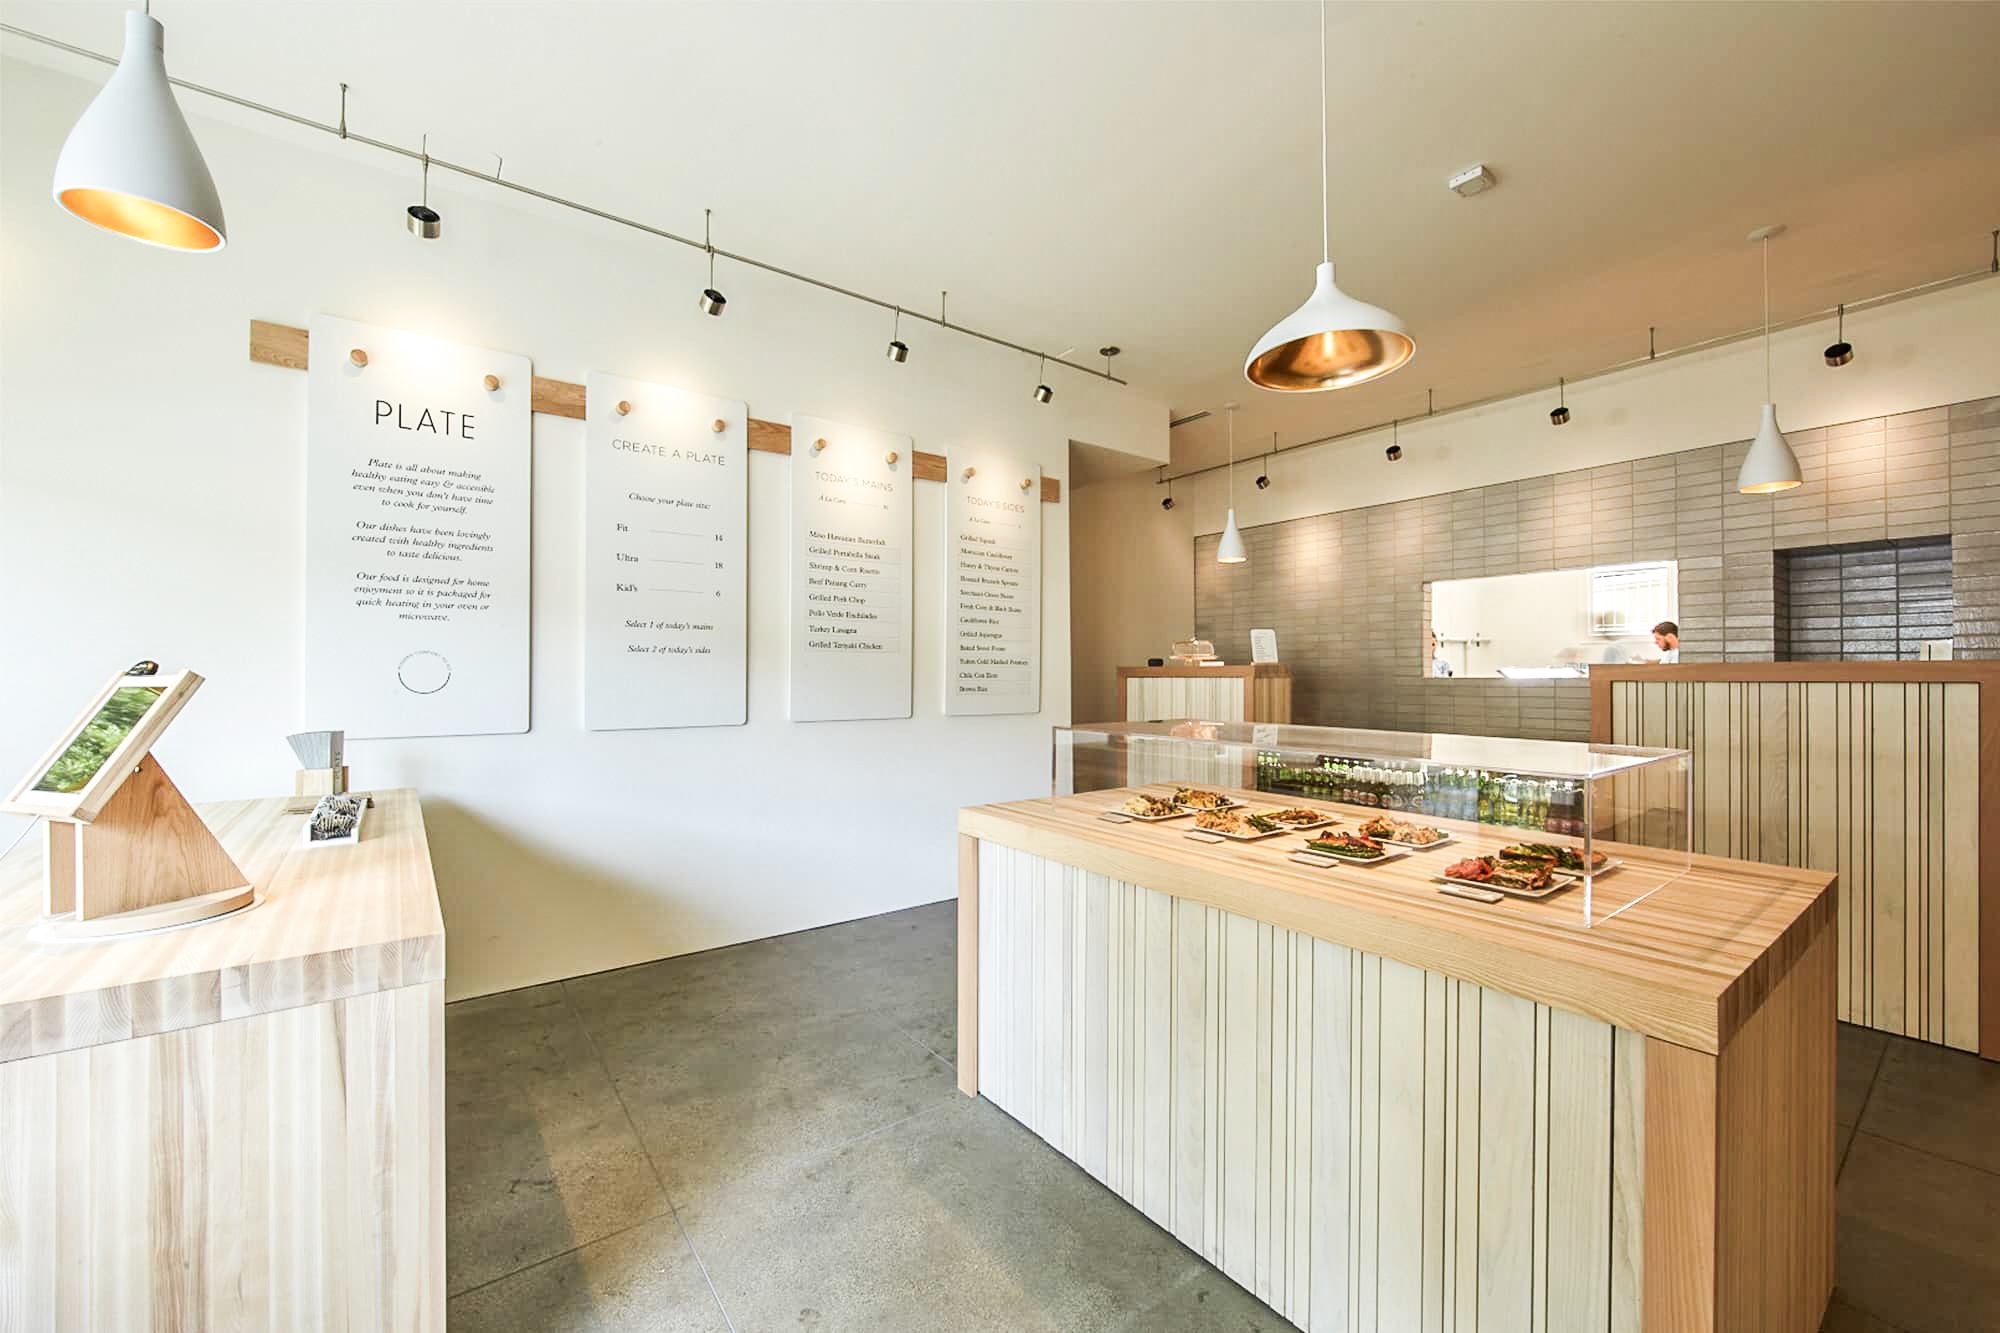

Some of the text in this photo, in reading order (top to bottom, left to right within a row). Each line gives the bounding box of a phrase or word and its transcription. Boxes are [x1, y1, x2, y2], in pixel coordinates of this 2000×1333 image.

[376, 400, 475, 440] PLATE
[612, 439, 725, 466] CREATE A PLATE
[368, 458, 481, 481] Plate is all about making
[352, 469, 495, 494] healthy eating easy & accessible
[353, 484, 375, 492] even
[379, 486, 403, 494] when
[426, 491, 448, 499] don't
[452, 494, 472, 502] have
[475, 496, 493, 504] time
[629, 492, 656, 502] Choose
[657, 497, 673, 505] your
[676, 498, 694, 507] plate
[416, 502, 430, 511] for
[431, 505, 468, 515] yourself.
[968, 496, 1024, 512] TODAY'S SIDES
[356, 521, 491, 541] Our dishes have been lovingly
[617, 523, 628, 532] Fit
[352, 535, 386, 543] created
[413, 539, 445, 549] healthy
[448, 542, 493, 552] ingredients
[423, 551, 462, 562] delicious.
[809, 546, 831, 555] Grilled
[616, 553, 638, 562] Ultra
[809, 562, 832, 571] Shrimp
[356, 571, 489, 587] Our food is designed for home
[849, 581, 867, 589] Curry
[354, 584, 402, 595] enjoyment
[427, 588, 433, 596] is
[436, 589, 477, 599] packaged
[478, 591, 491, 600] for
[616, 584, 638, 592] Kid's
[356, 598, 382, 607] quick
[386, 599, 419, 609] heating
[423, 600, 431, 608] in
[433, 602, 454, 610] your
[399, 612, 450, 621] microwave.
[625, 620, 647, 628] Select
[656, 621, 663, 631] of
[665, 622, 690, 631] today's
[809, 625, 830, 633] Turkey
[628, 645, 649, 653] Select
[659, 645, 666, 654] of
[668, 646, 693, 654] today's
